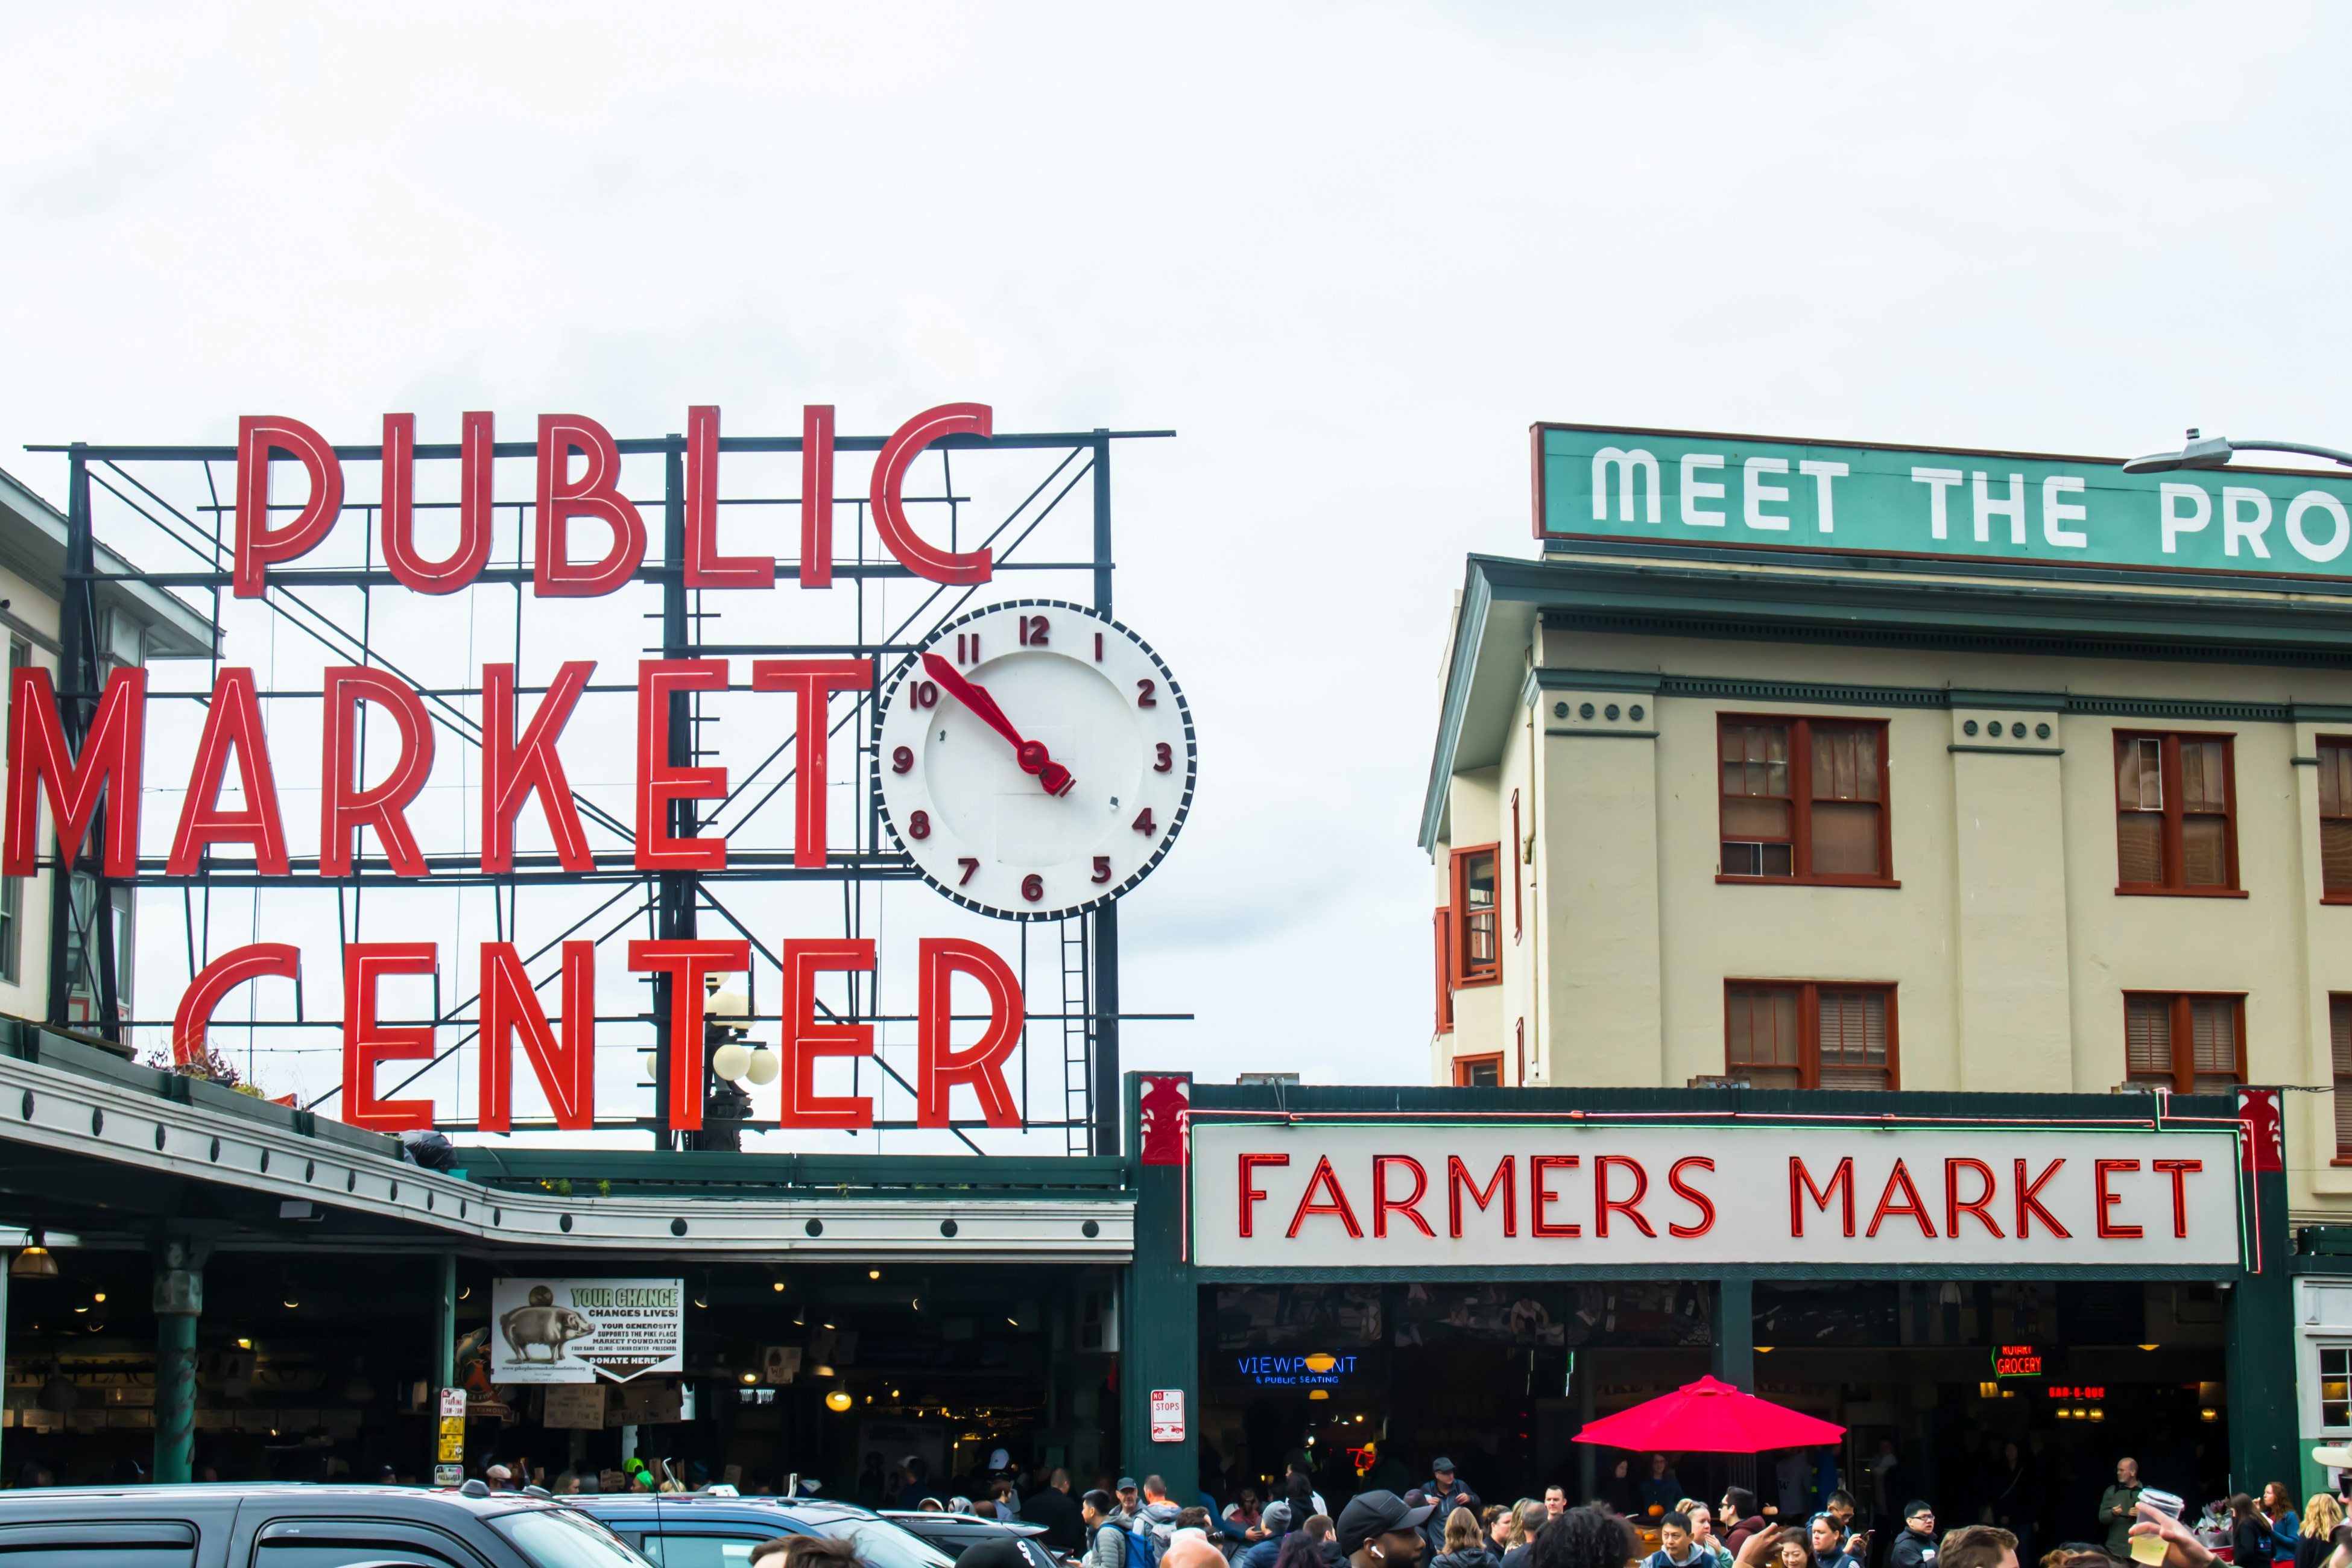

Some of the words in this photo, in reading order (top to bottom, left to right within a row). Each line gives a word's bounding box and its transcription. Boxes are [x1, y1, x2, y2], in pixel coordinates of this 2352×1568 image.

[233, 402, 992, 598] PUBLIC
[1592, 447, 1849, 533] MEET
[1911, 467, 2087, 548] THE
[2160, 482, 2350, 562] PRO
[1019, 615, 1050, 646] 12
[958, 633, 979, 665] 11
[1095, 633, 1103, 662] 1
[910, 680, 938, 710] 10
[1137, 679, 1157, 707] 2
[2, 659, 874, 877] MARKET
[892, 745, 914, 774] 9
[1153, 742, 1173, 773] 3
[909, 810, 931, 839] 8
[1131, 807, 1157, 836] 4
[958, 857, 980, 886] 7
[1091, 856, 1111, 884] 5
[1021, 874, 1043, 902] 6
[173, 937, 1025, 1132] CENTER
[1238, 1153, 1716, 1239] FARMERS
[1789, 1158, 2203, 1239] MARKET
[571, 1288, 613, 1307] YOUR
[616, 1288, 678, 1307] CHANGE
[1238, 1356, 1358, 1373] VIEWPNT
[1997, 1356, 2041, 1374] GROCERY
[1256, 1376, 1262, 1384] &
[1265, 1376, 1296, 1385] PUBLIC
